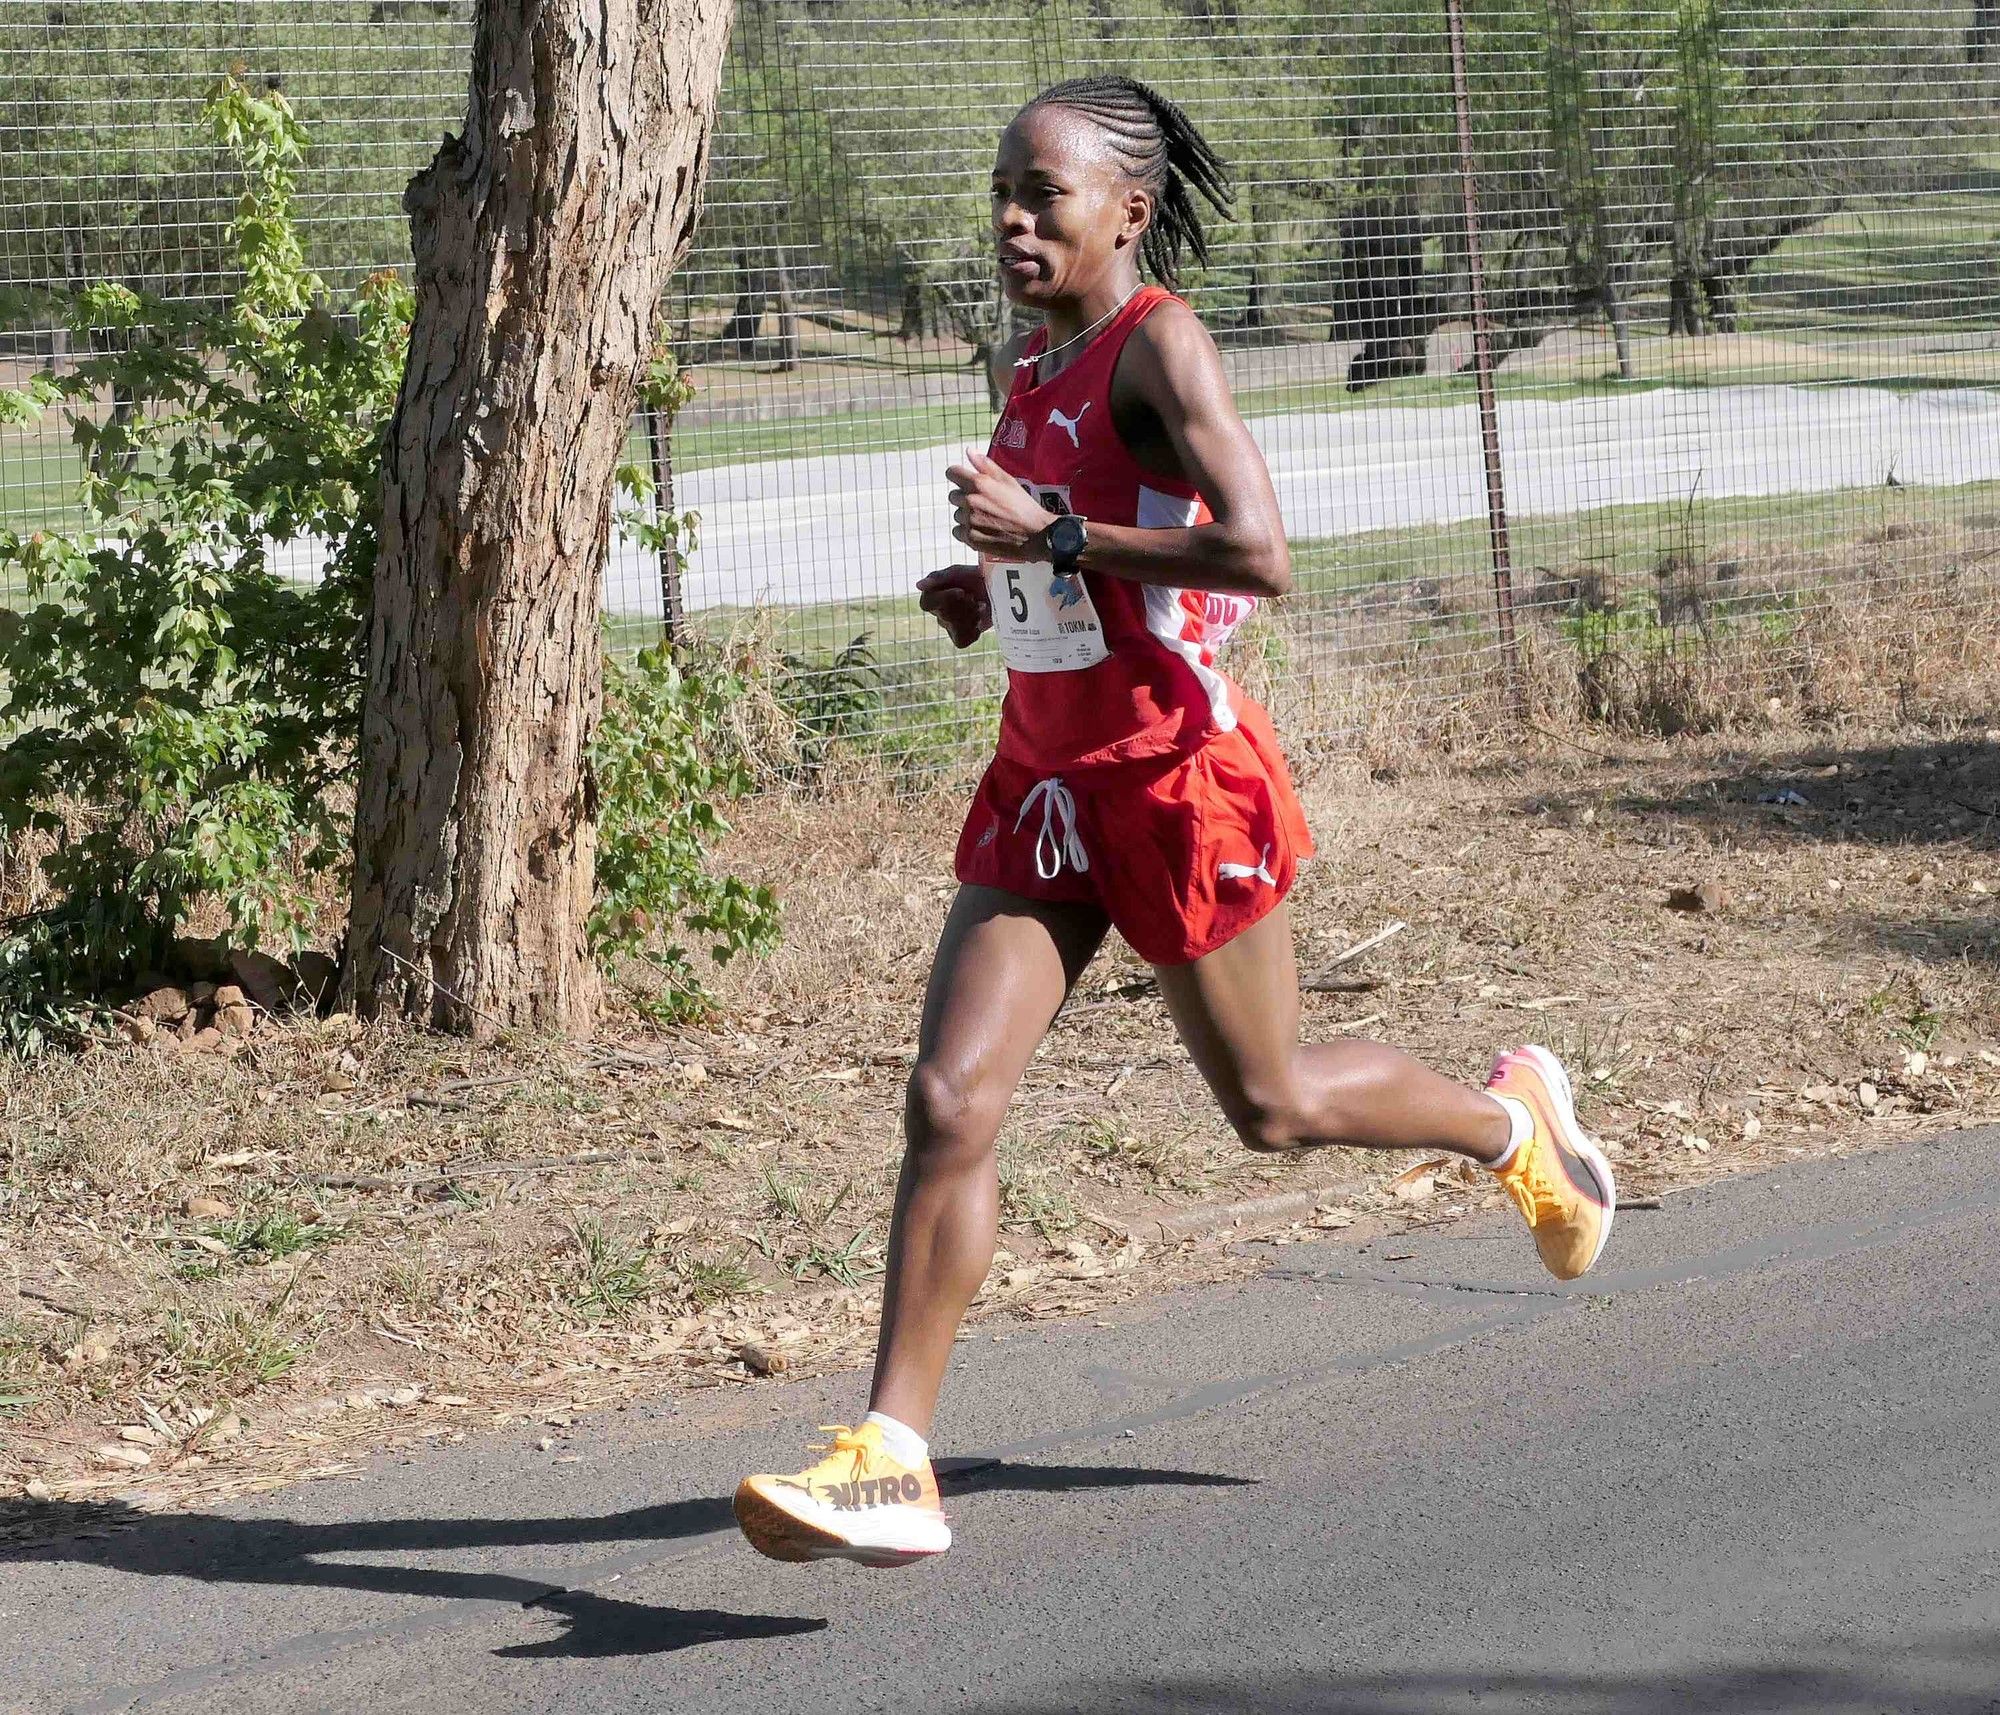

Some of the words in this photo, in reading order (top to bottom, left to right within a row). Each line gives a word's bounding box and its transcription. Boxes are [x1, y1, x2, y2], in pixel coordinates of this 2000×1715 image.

[1006, 569, 1029, 623] 5
[1064, 620, 1087, 634] 10KM
[816, 1473, 921, 1512] NITRO
